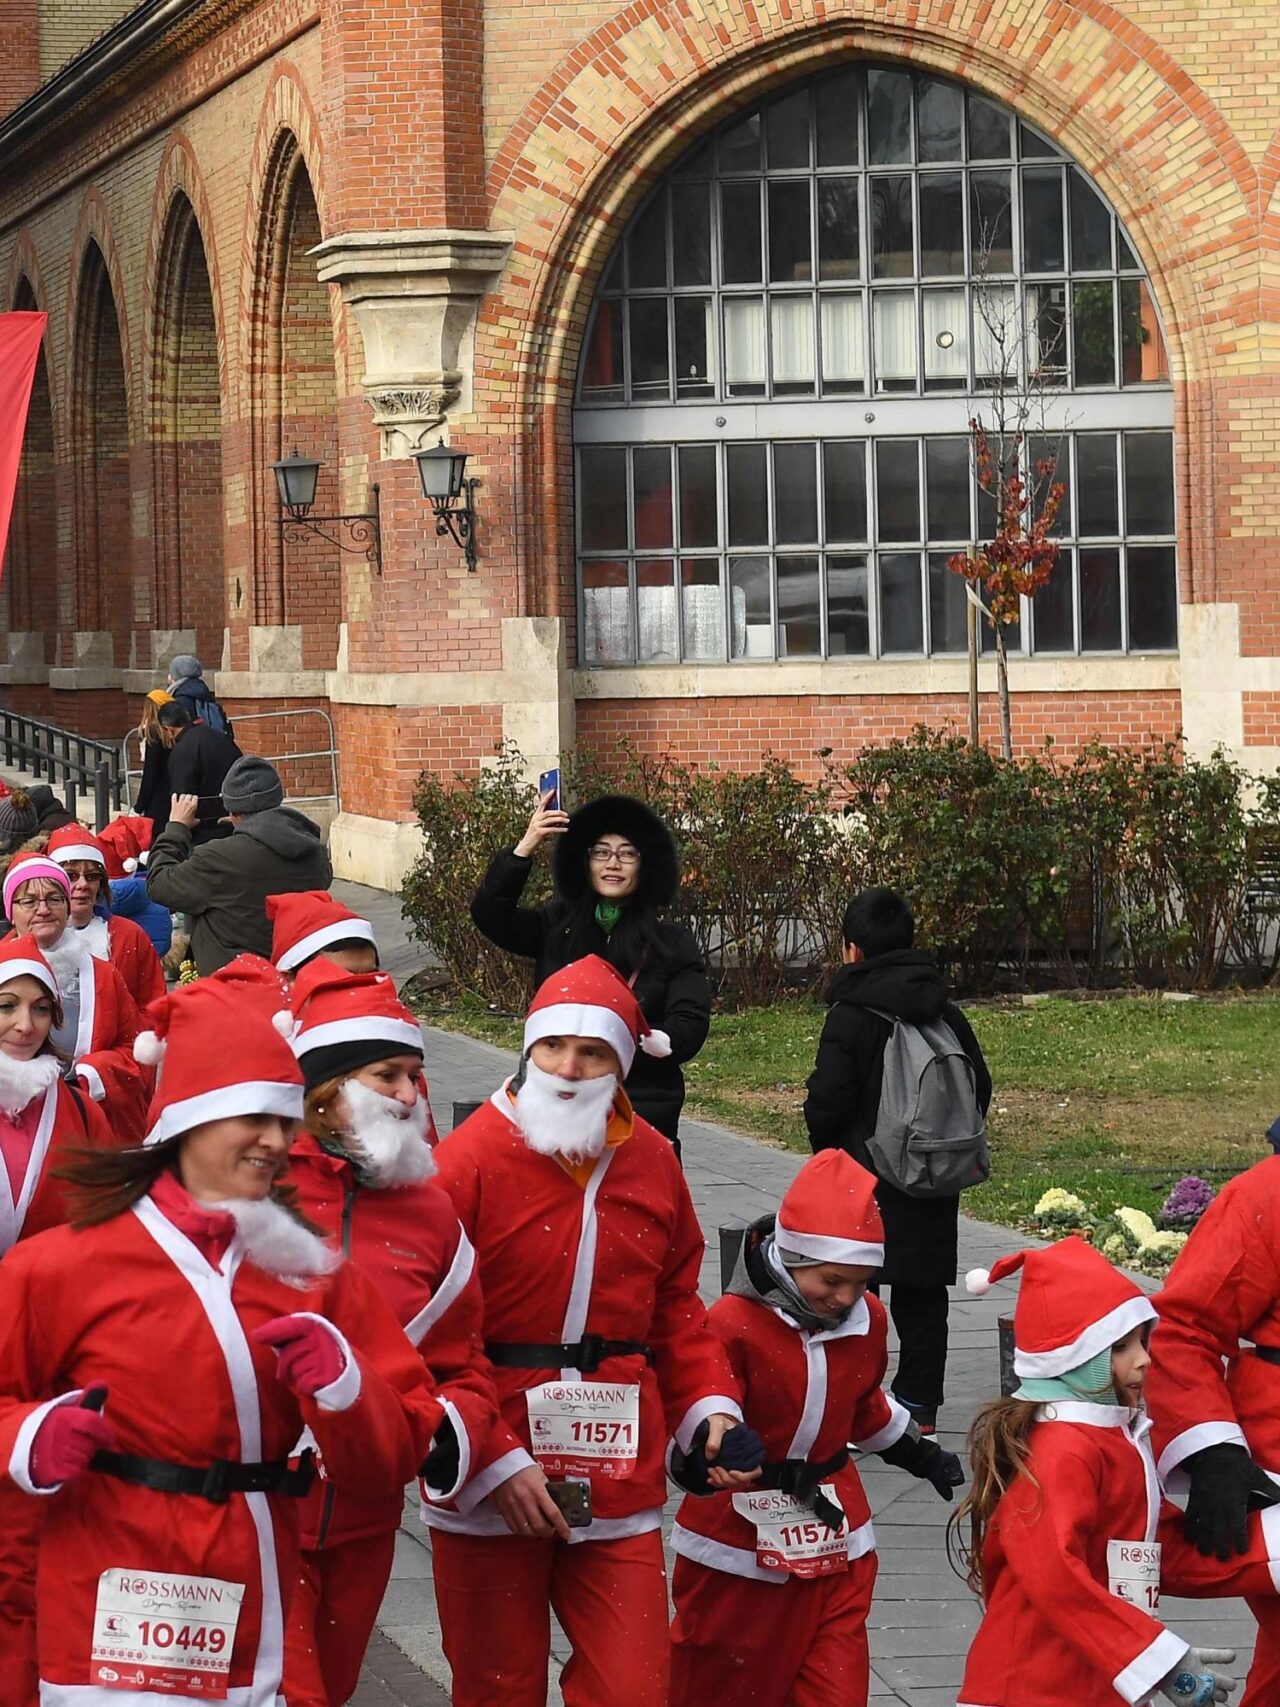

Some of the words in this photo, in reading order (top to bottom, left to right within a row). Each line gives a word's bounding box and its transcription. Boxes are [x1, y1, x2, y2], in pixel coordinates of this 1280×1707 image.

[543, 1386, 626, 1403] ROSSMANN
[571, 1421, 632, 1443] 11571
[780, 1522, 845, 1546] 11572
[1120, 1547, 1159, 1563] ROSS
[120, 1577, 223, 1603] ROSSMANN
[1145, 1586, 1160, 1609] 12
[138, 1621, 226, 1654] 10449
